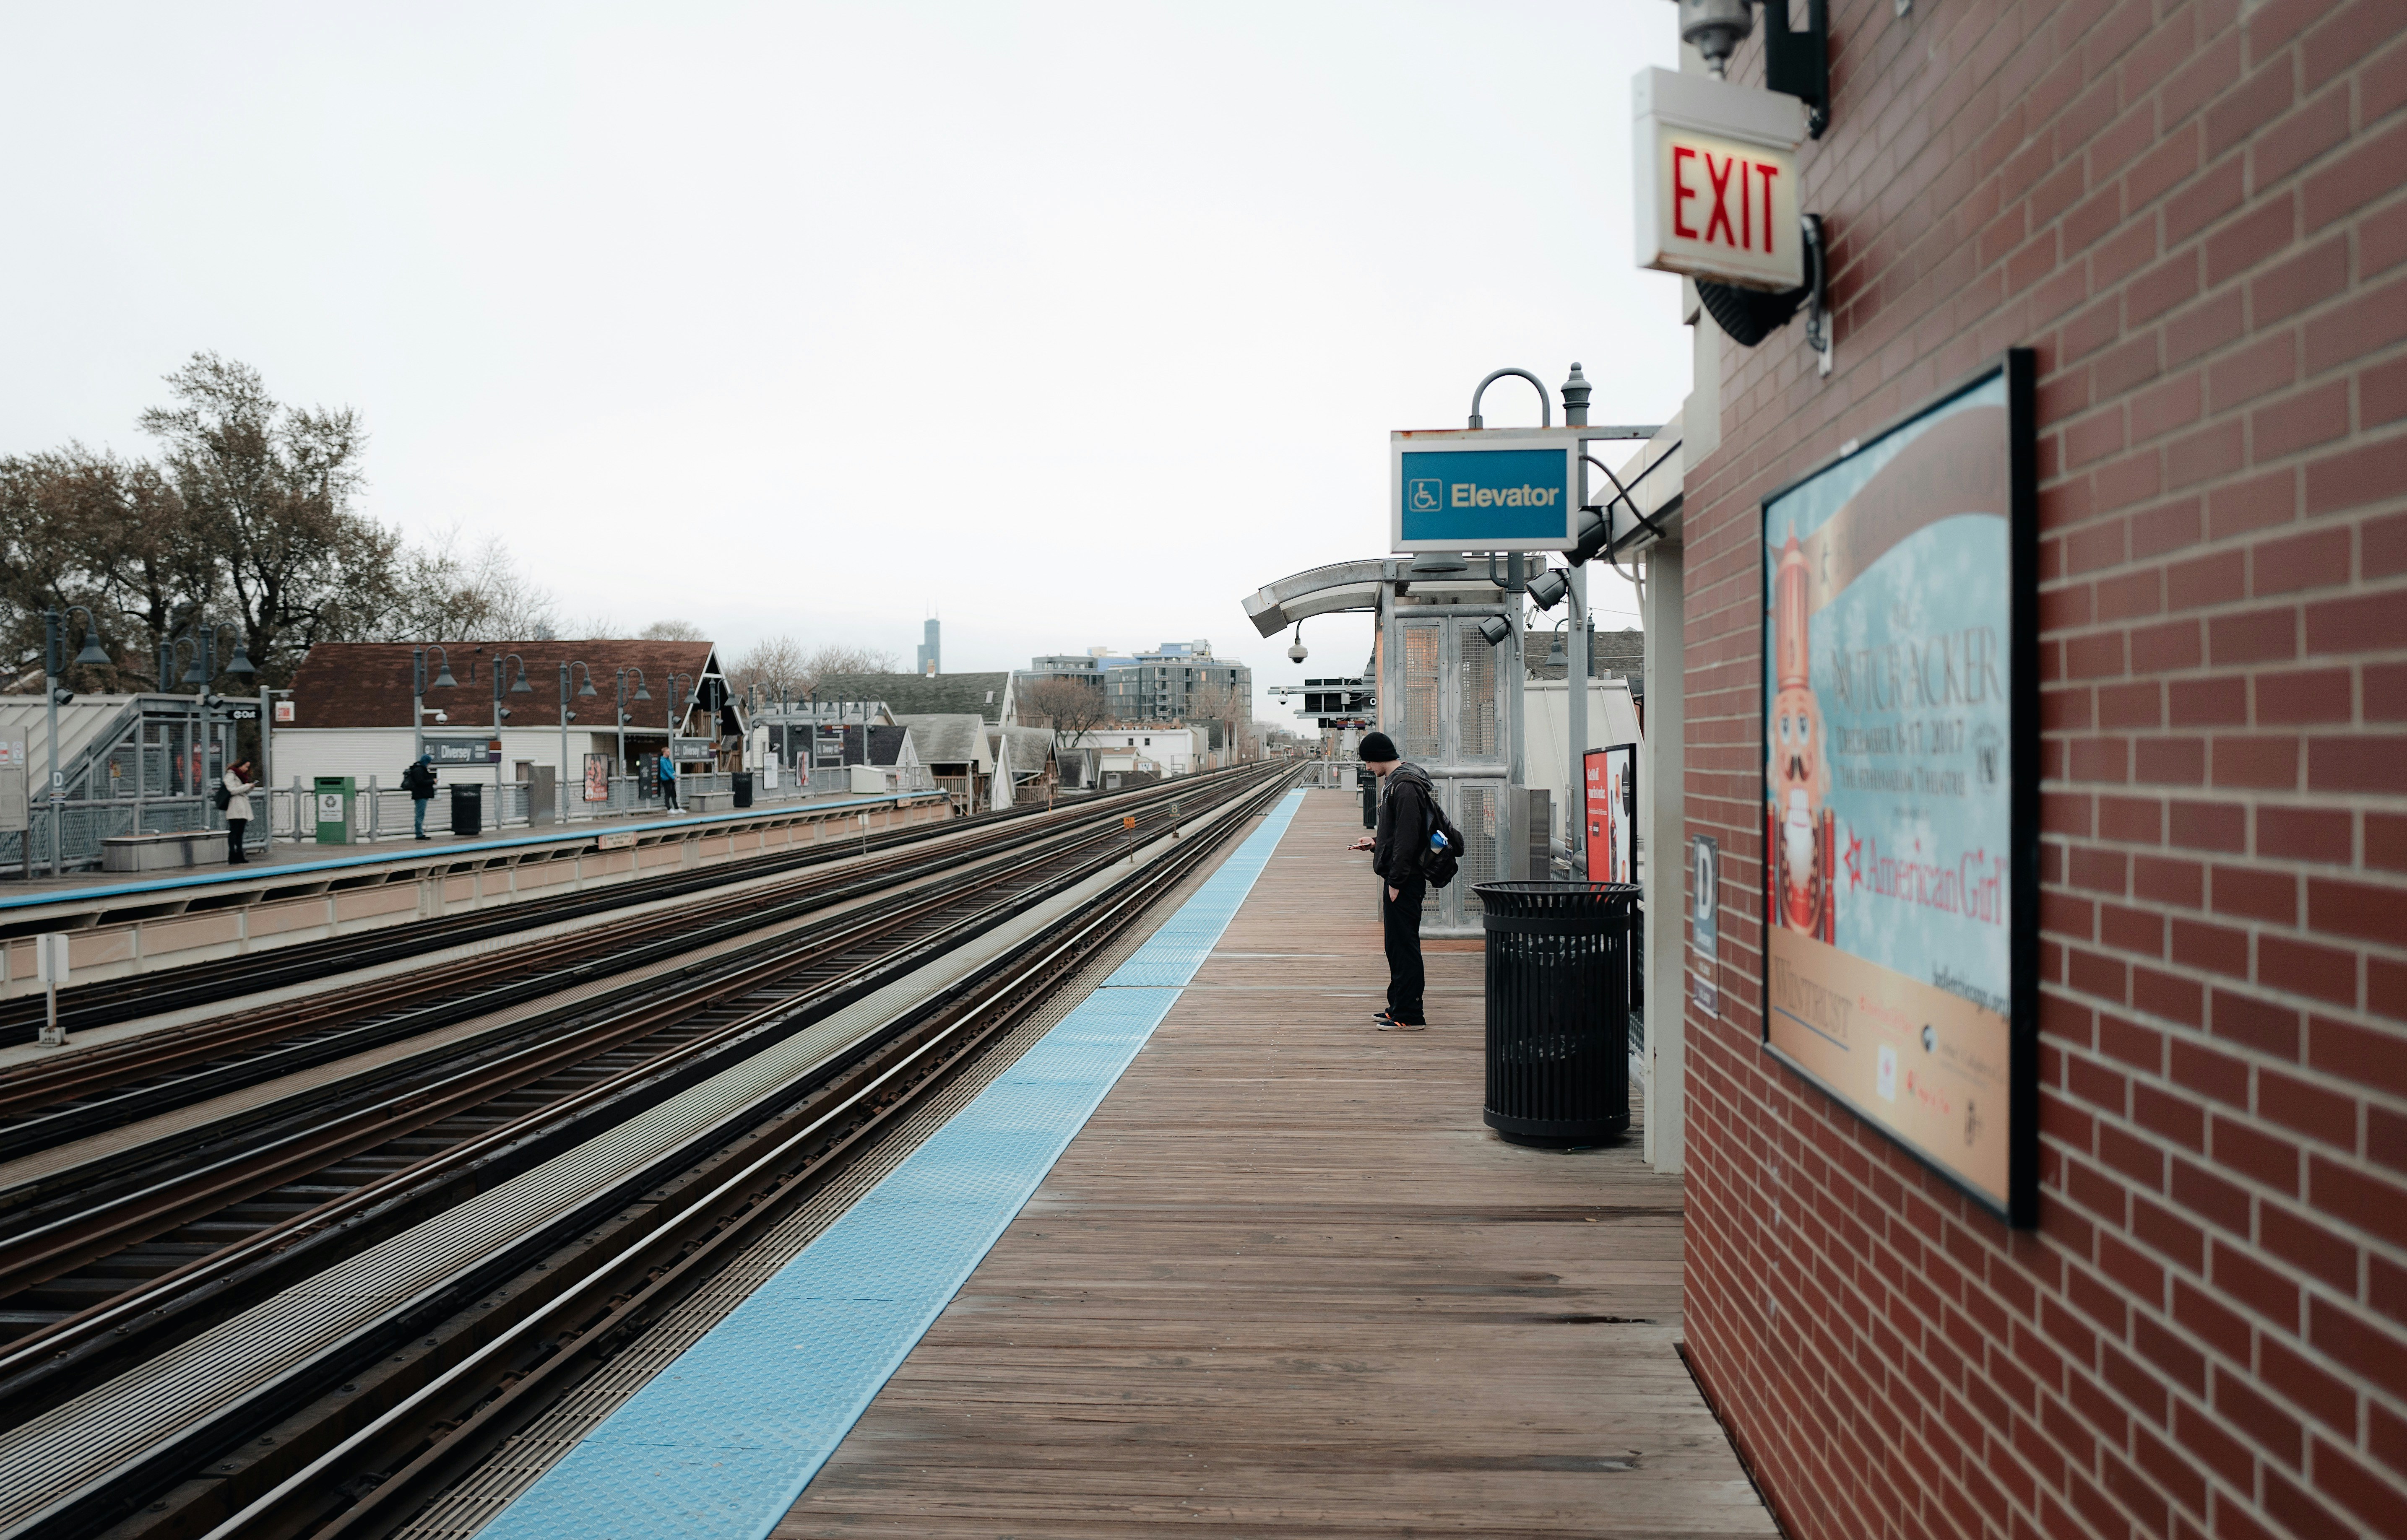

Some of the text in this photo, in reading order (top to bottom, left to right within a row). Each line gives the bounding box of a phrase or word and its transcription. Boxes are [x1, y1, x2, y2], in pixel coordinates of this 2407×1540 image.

[1673, 146, 1780, 254] EXIT
[1451, 483, 1559, 508] Elevator
[1829, 626, 2003, 714] NUTCRACKER
[441, 745, 471, 762] Diversey
[683, 745, 699, 758] Diversey
[1931, 719, 1964, 755] 2017
[53, 771, 62, 787] D
[1171, 804, 1178, 813] 8
[1698, 842, 1713, 921] D
[1866, 837, 2004, 925] American Girl
[1773, 955, 1853, 1039] WINTRUST
